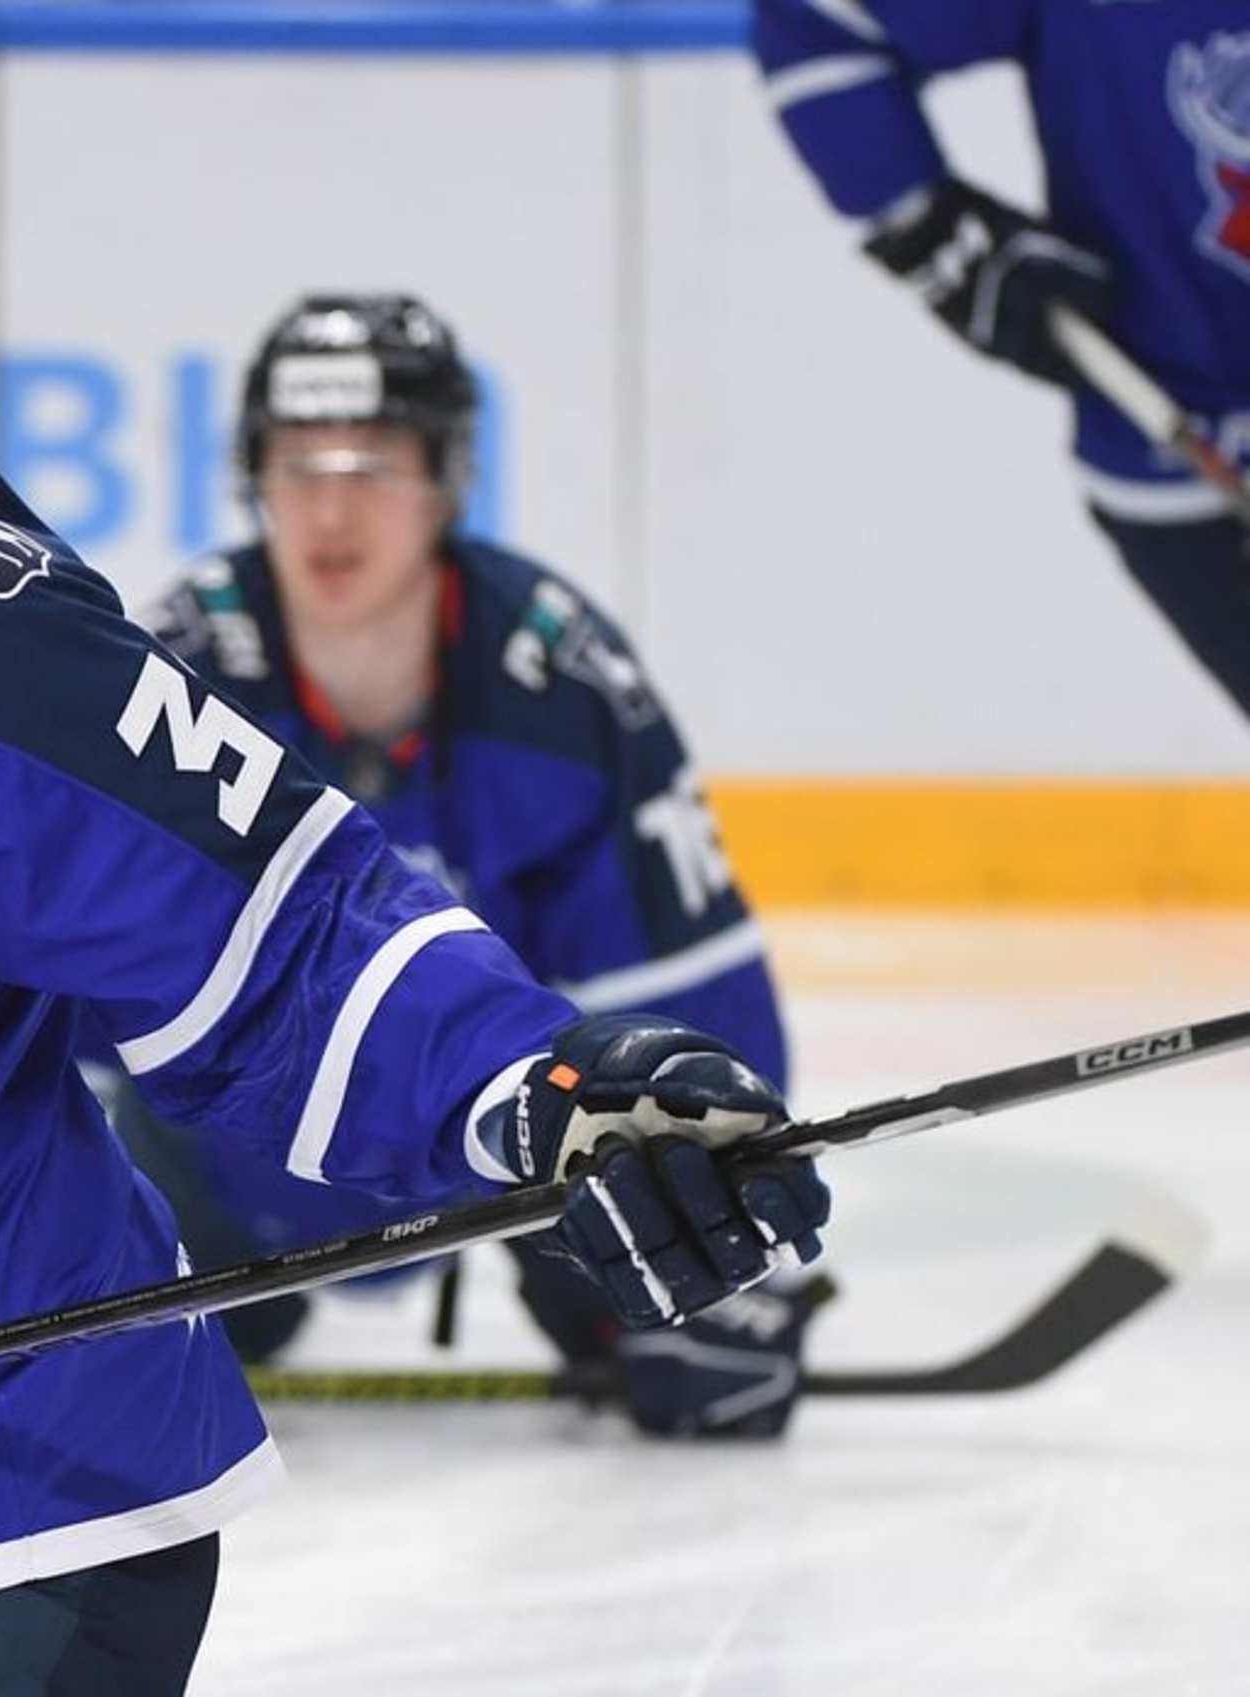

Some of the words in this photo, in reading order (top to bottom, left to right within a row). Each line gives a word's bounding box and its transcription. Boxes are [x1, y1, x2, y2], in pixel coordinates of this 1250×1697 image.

[116, 651, 286, 838] 3
[1087, 1034, 1182, 1070] CCM
[516, 1084, 536, 1176] CCM
